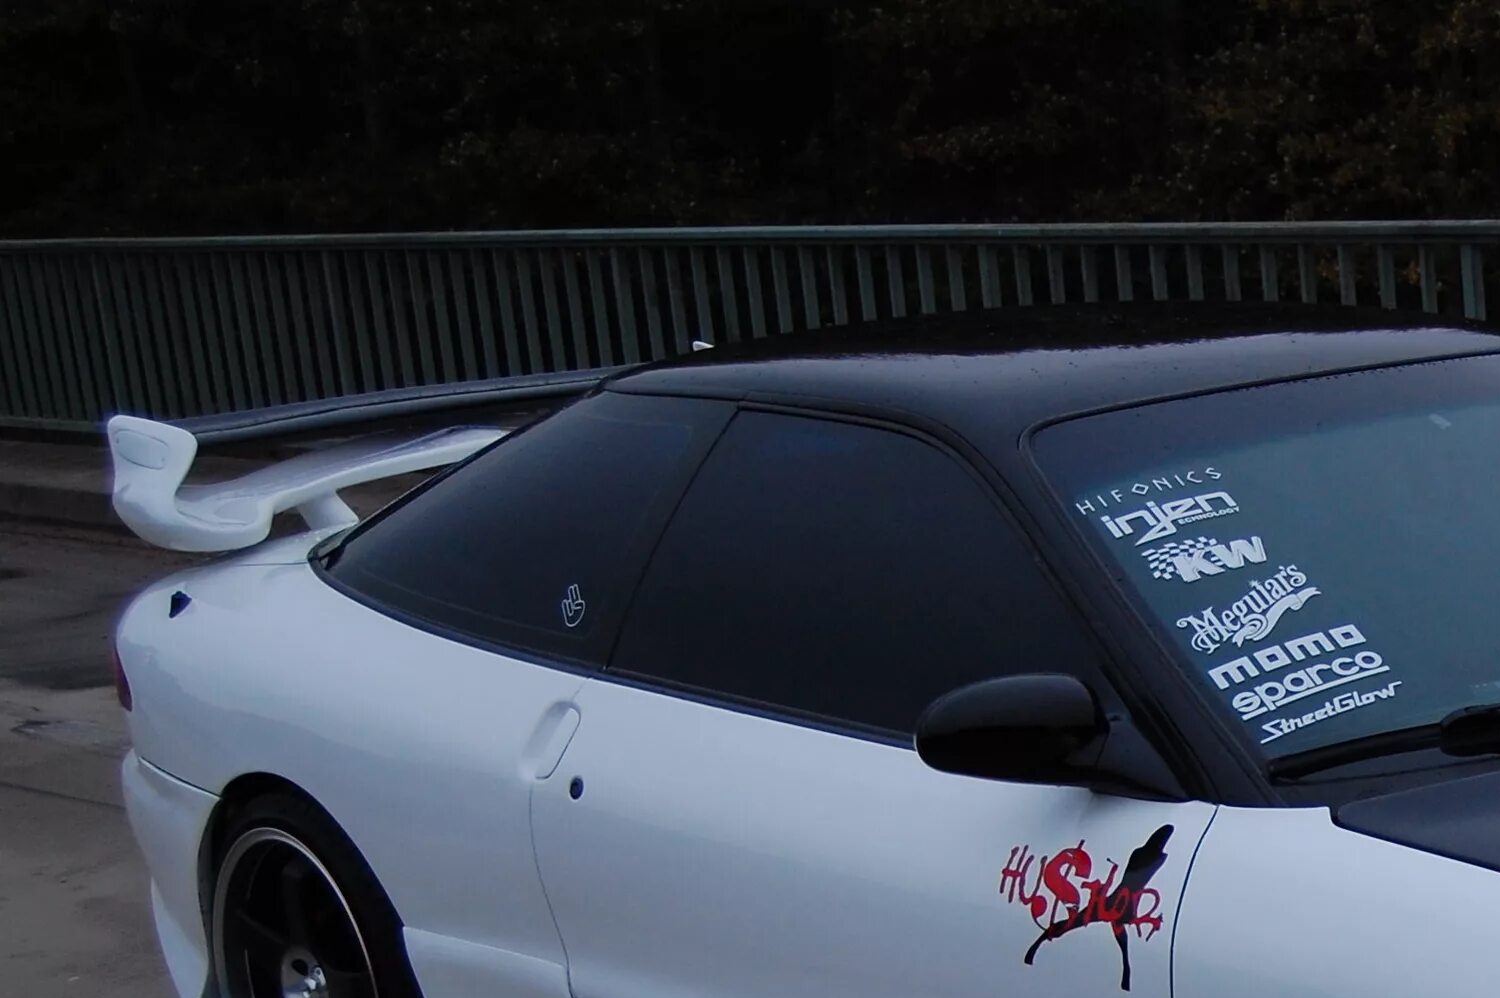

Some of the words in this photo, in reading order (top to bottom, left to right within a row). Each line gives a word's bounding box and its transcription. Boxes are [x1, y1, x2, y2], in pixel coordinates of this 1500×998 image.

[1075, 466, 1222, 516] HIFONICS
[1100, 490, 1238, 547] injen
[1171, 535, 1267, 583] KW
[1231, 650, 1383, 722] sparco
